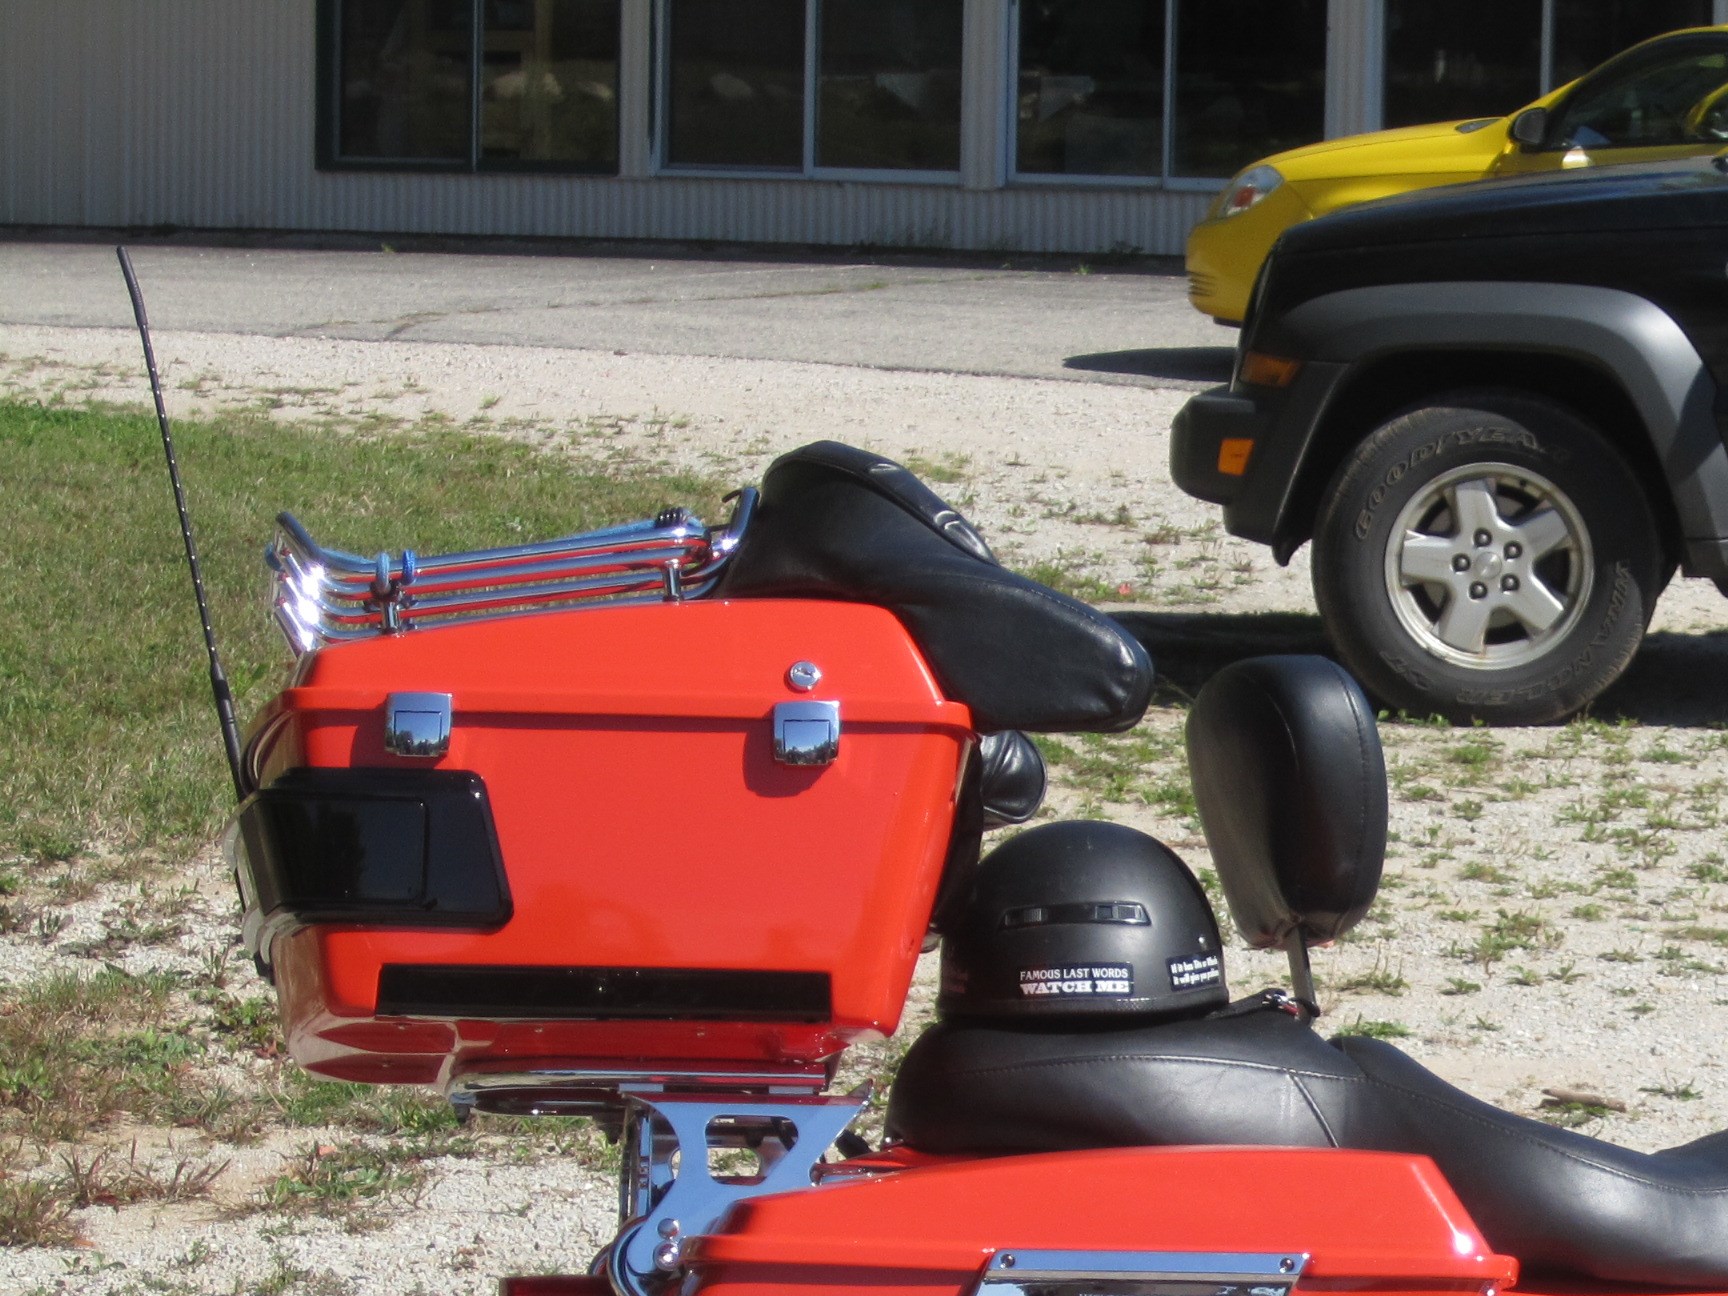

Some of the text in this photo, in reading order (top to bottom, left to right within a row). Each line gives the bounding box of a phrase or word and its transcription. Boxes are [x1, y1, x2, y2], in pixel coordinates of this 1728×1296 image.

[1355, 425, 1569, 541] GOODYEA
[1019, 967, 1129, 981] FAMOUS LAST WORDS
[1019, 980, 1130, 995] WATCH ME
